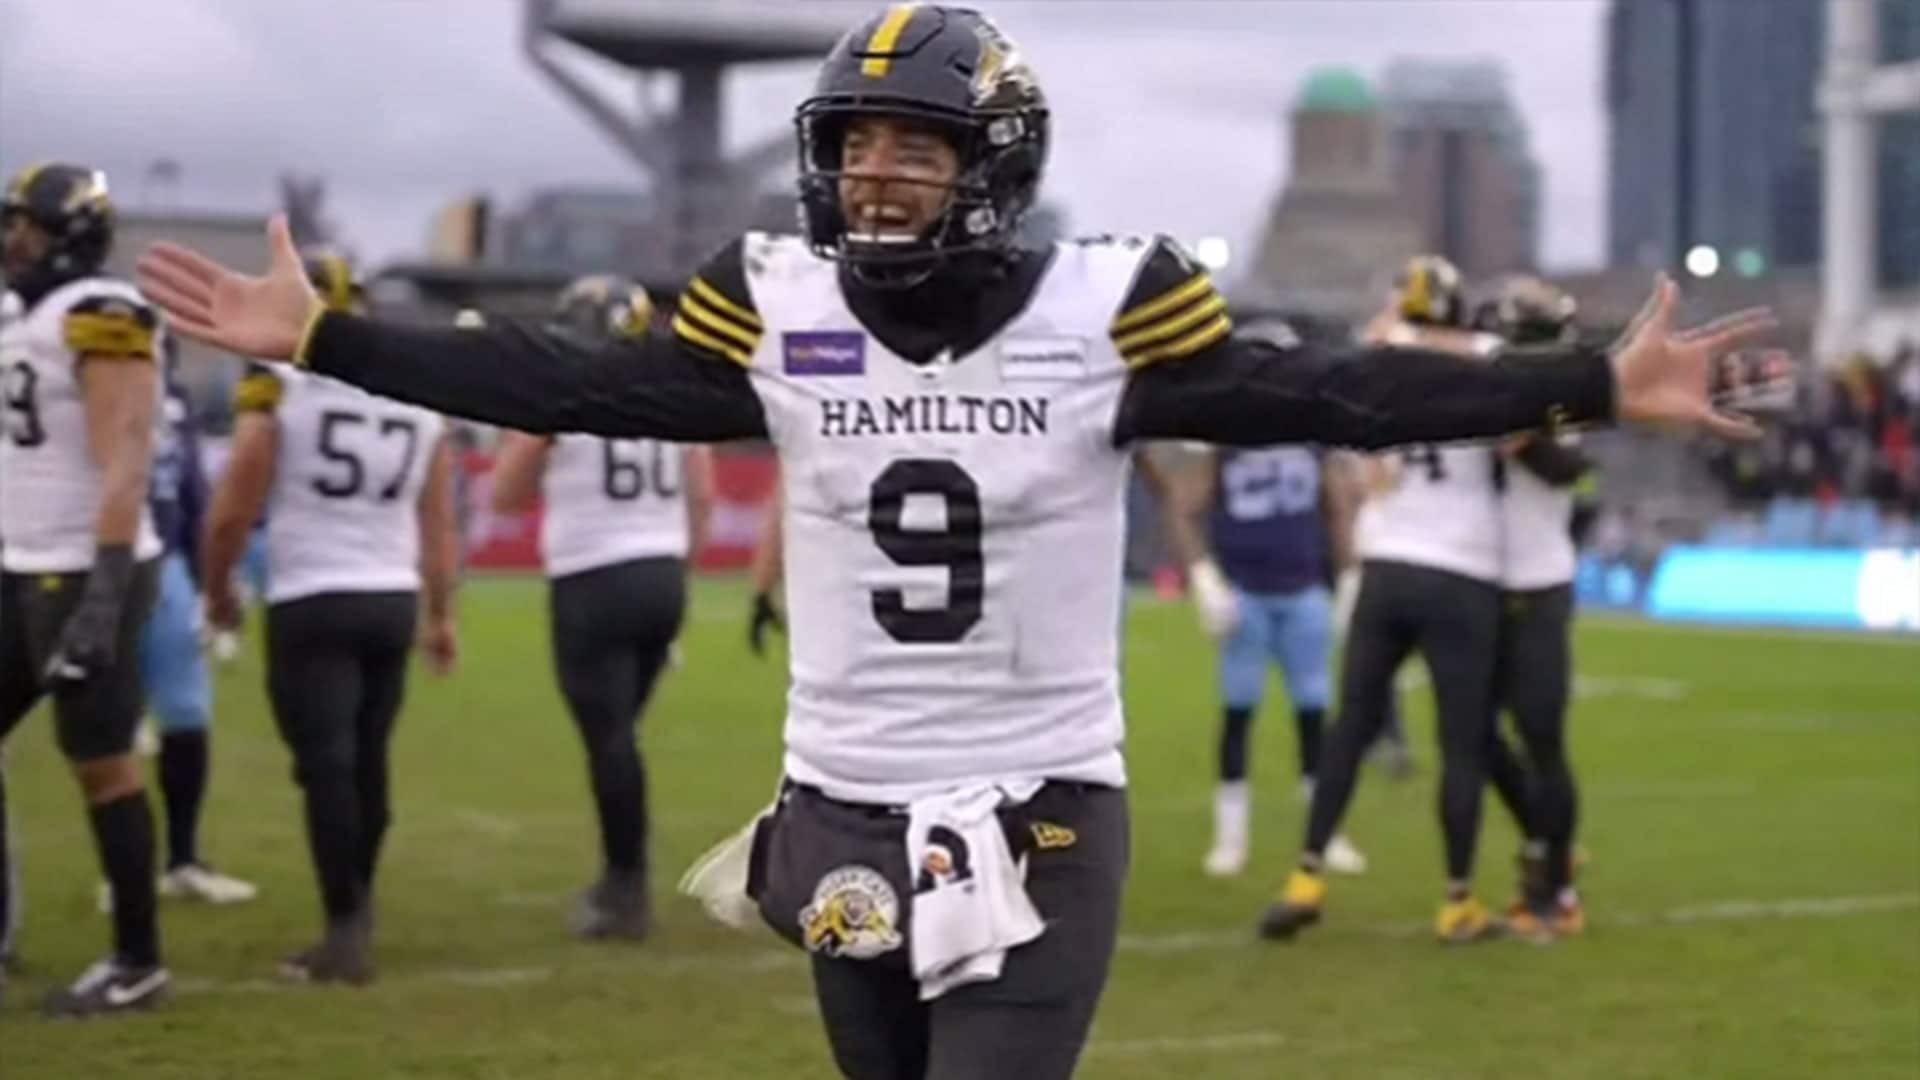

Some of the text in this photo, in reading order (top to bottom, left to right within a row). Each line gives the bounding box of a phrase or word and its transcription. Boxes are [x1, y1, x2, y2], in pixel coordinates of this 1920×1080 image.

[312, 410, 416, 501] 57
[820, 396, 1048, 436] HAMILTON
[868, 459, 984, 643] 9
